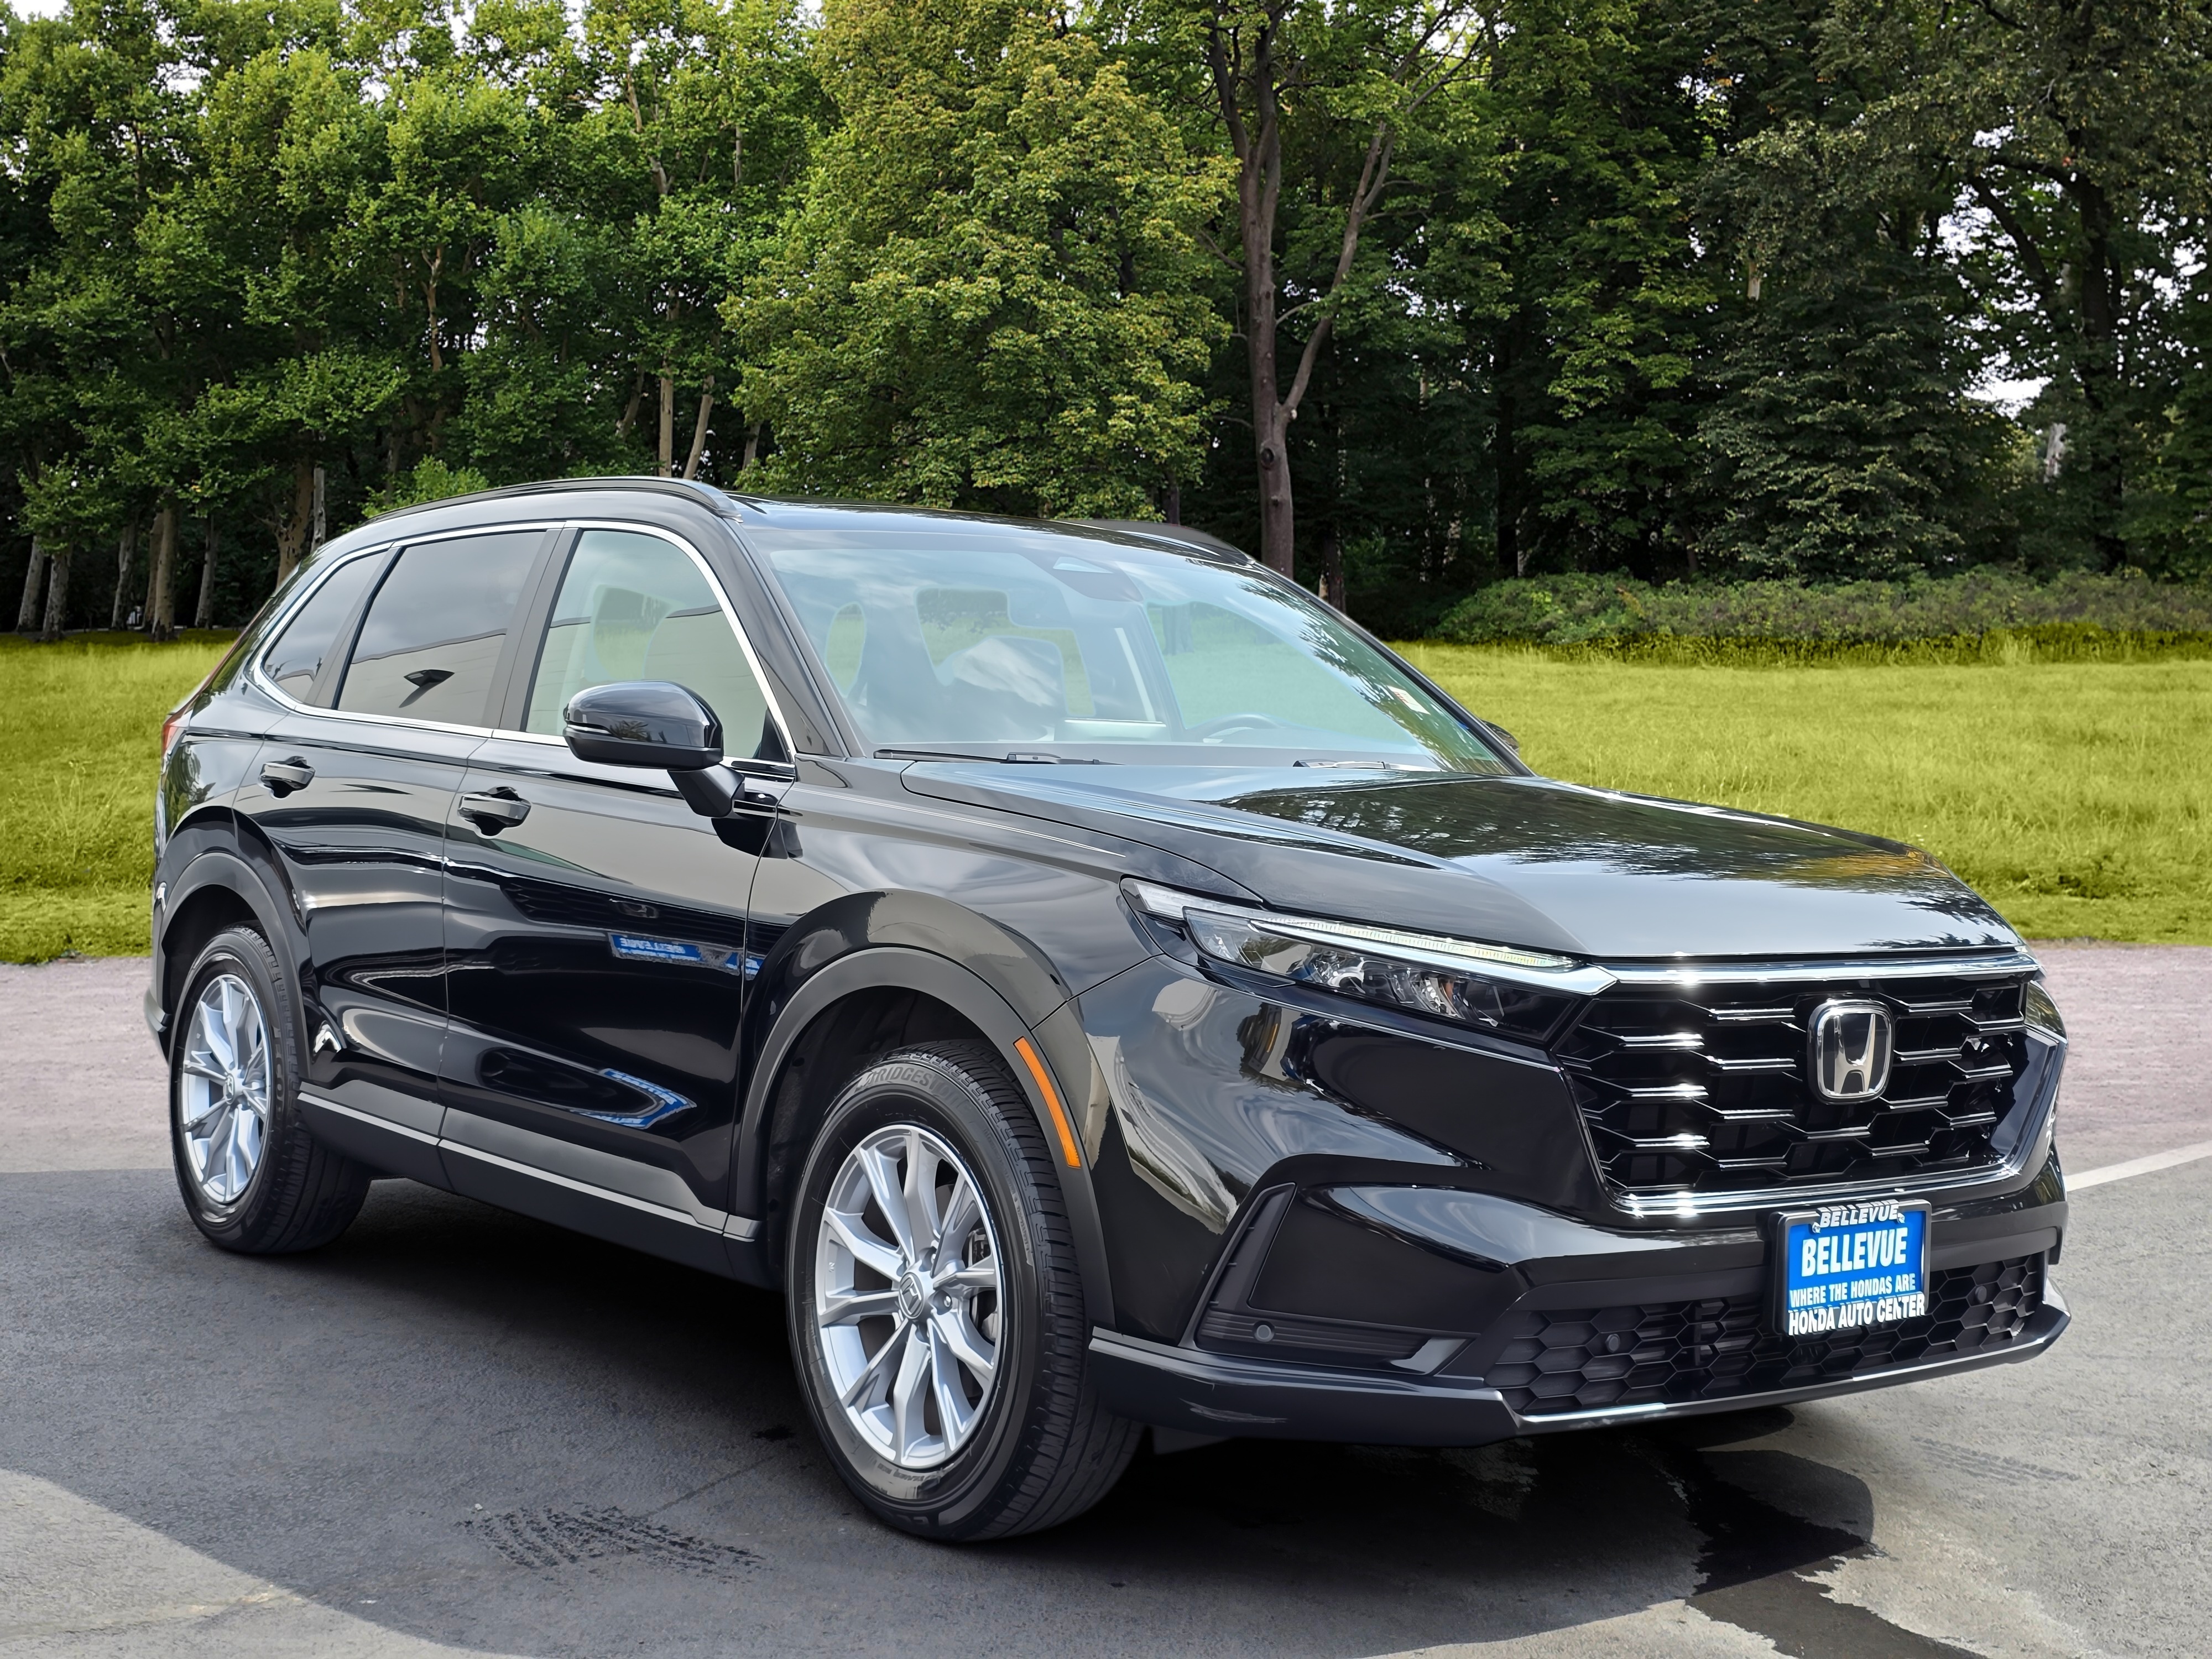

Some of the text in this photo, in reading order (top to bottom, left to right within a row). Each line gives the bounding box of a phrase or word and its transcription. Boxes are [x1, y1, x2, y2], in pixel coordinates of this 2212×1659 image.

[868, 1066, 972, 1110] BRIDGESTON
[1819, 1204, 1899, 1228] BELLEVUE
[1801, 1227, 1908, 1277] BELLEVUE
[1790, 1273, 1916, 1308] WHERE THE HONDAS ARE
[1788, 1293, 1925, 1335] HONDA AUTO CENTER
